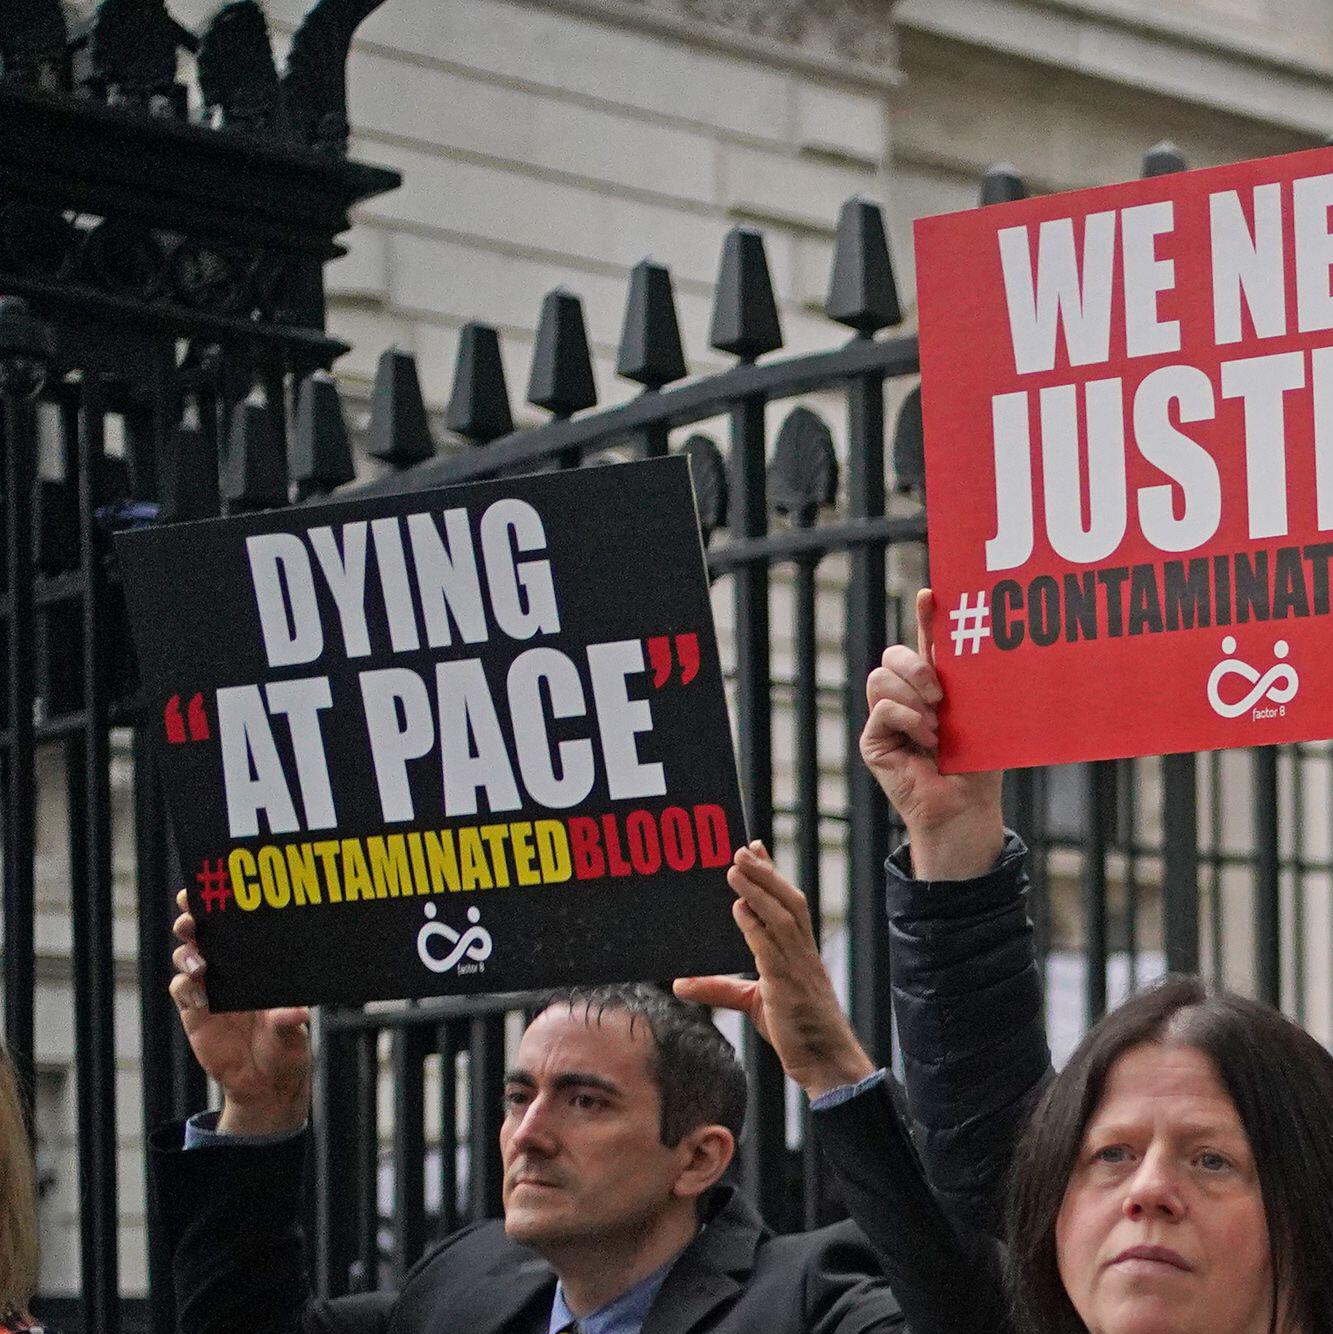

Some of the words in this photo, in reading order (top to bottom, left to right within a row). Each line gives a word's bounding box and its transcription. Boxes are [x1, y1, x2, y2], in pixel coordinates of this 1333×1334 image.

[998, 200, 1181, 375] WE
[245, 498, 560, 667] DYING
[1252, 707, 1278, 722] factor
[1279, 705, 1286, 717] 8
[197, 804, 731, 912] #CONTAMINATEDBLOOD
